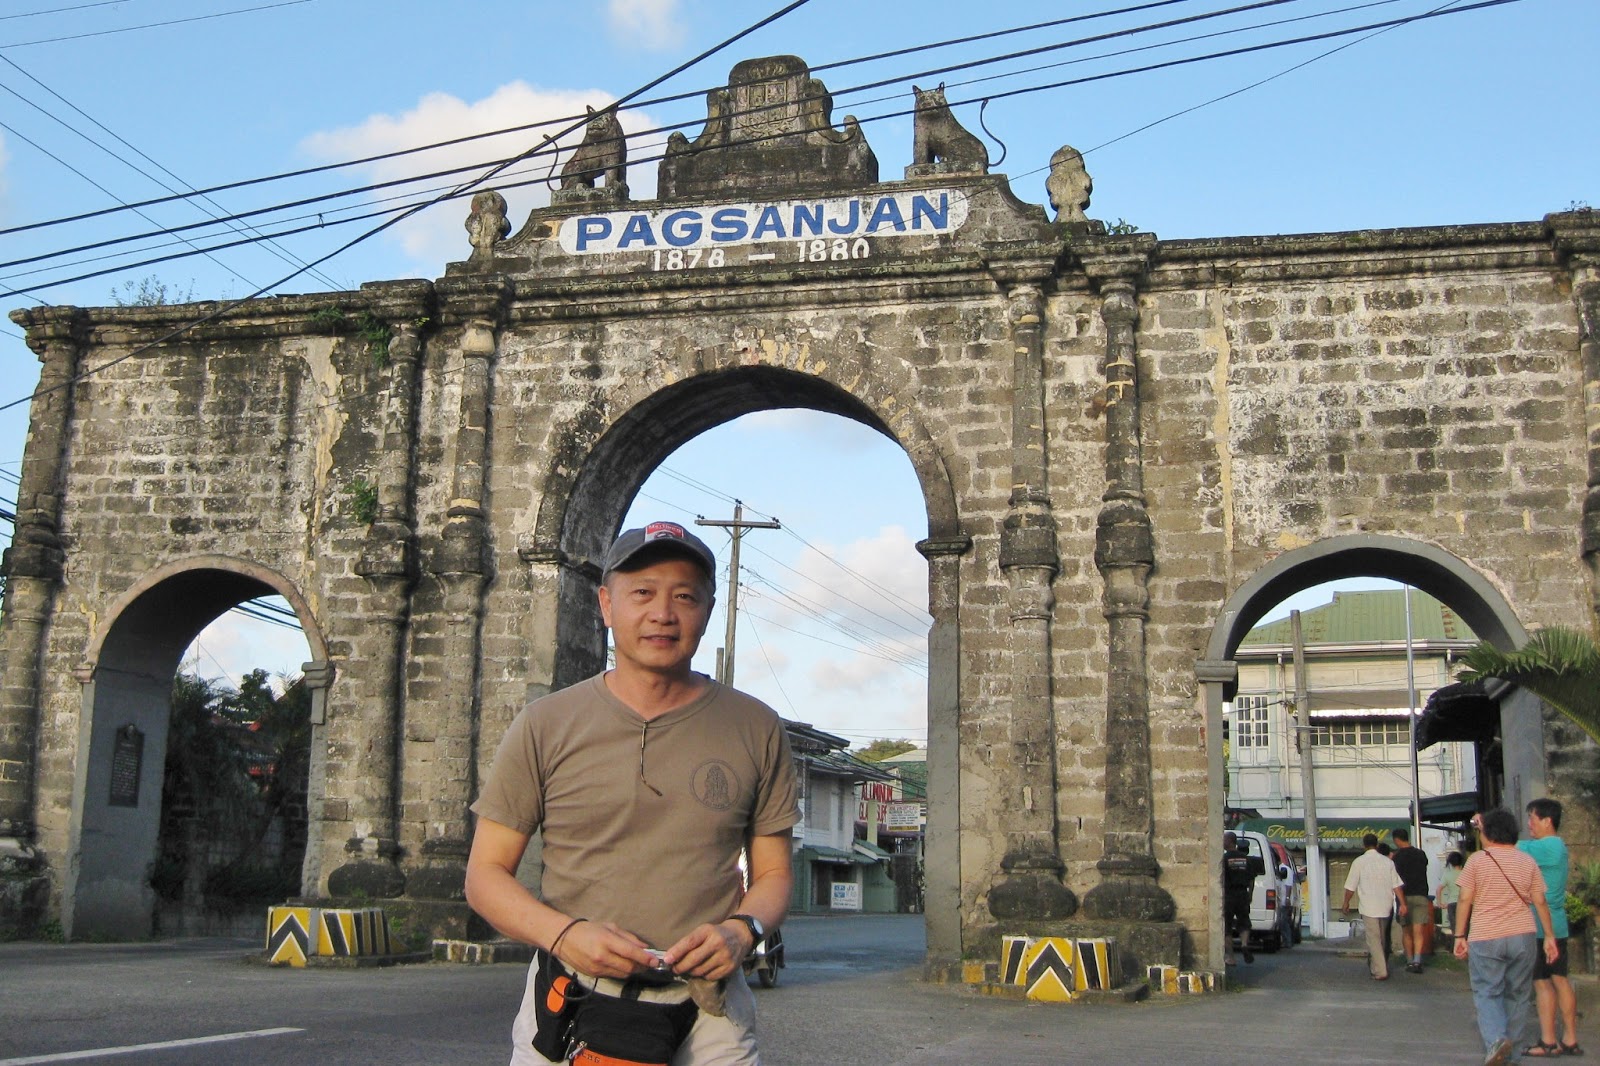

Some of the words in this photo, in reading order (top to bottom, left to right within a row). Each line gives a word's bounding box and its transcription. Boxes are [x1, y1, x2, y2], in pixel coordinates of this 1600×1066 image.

[576, 192, 949, 252] PAGSANJAN
[653, 248, 726, 272] 1878
[796, 237, 870, 263] 1880
